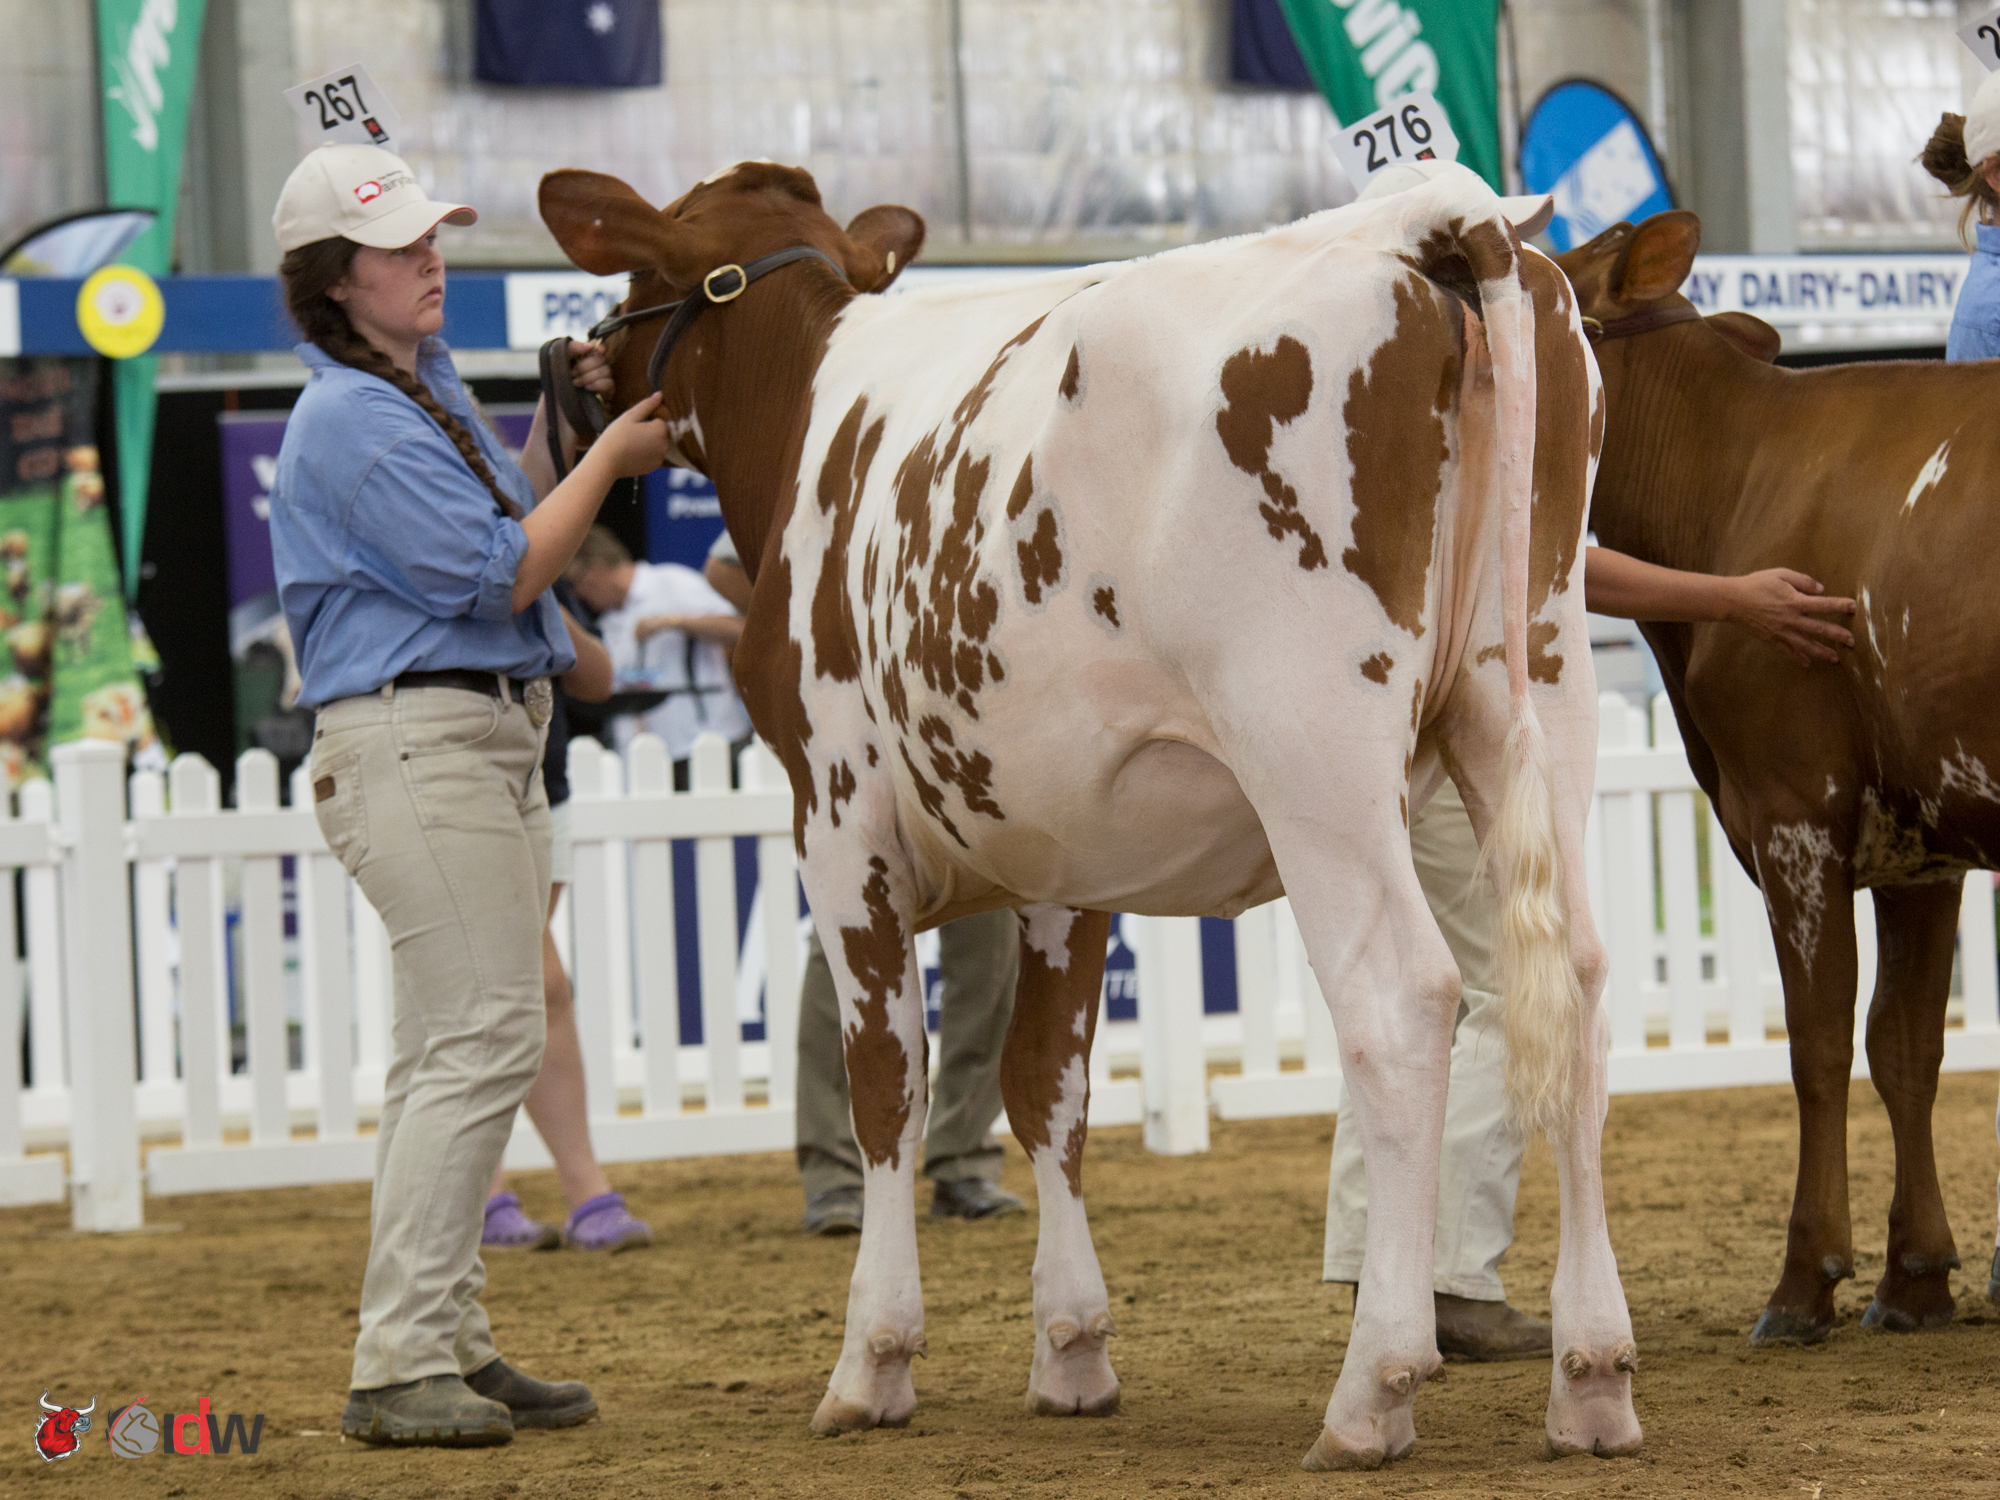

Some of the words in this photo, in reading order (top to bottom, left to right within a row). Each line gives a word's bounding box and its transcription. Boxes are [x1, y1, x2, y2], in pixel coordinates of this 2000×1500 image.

[304, 75, 368, 130] 267
[1353, 104, 1432, 173] 276
[543, 291, 619, 332] PRO
[1740, 271, 1957, 307] DAIRY-DAIRY
